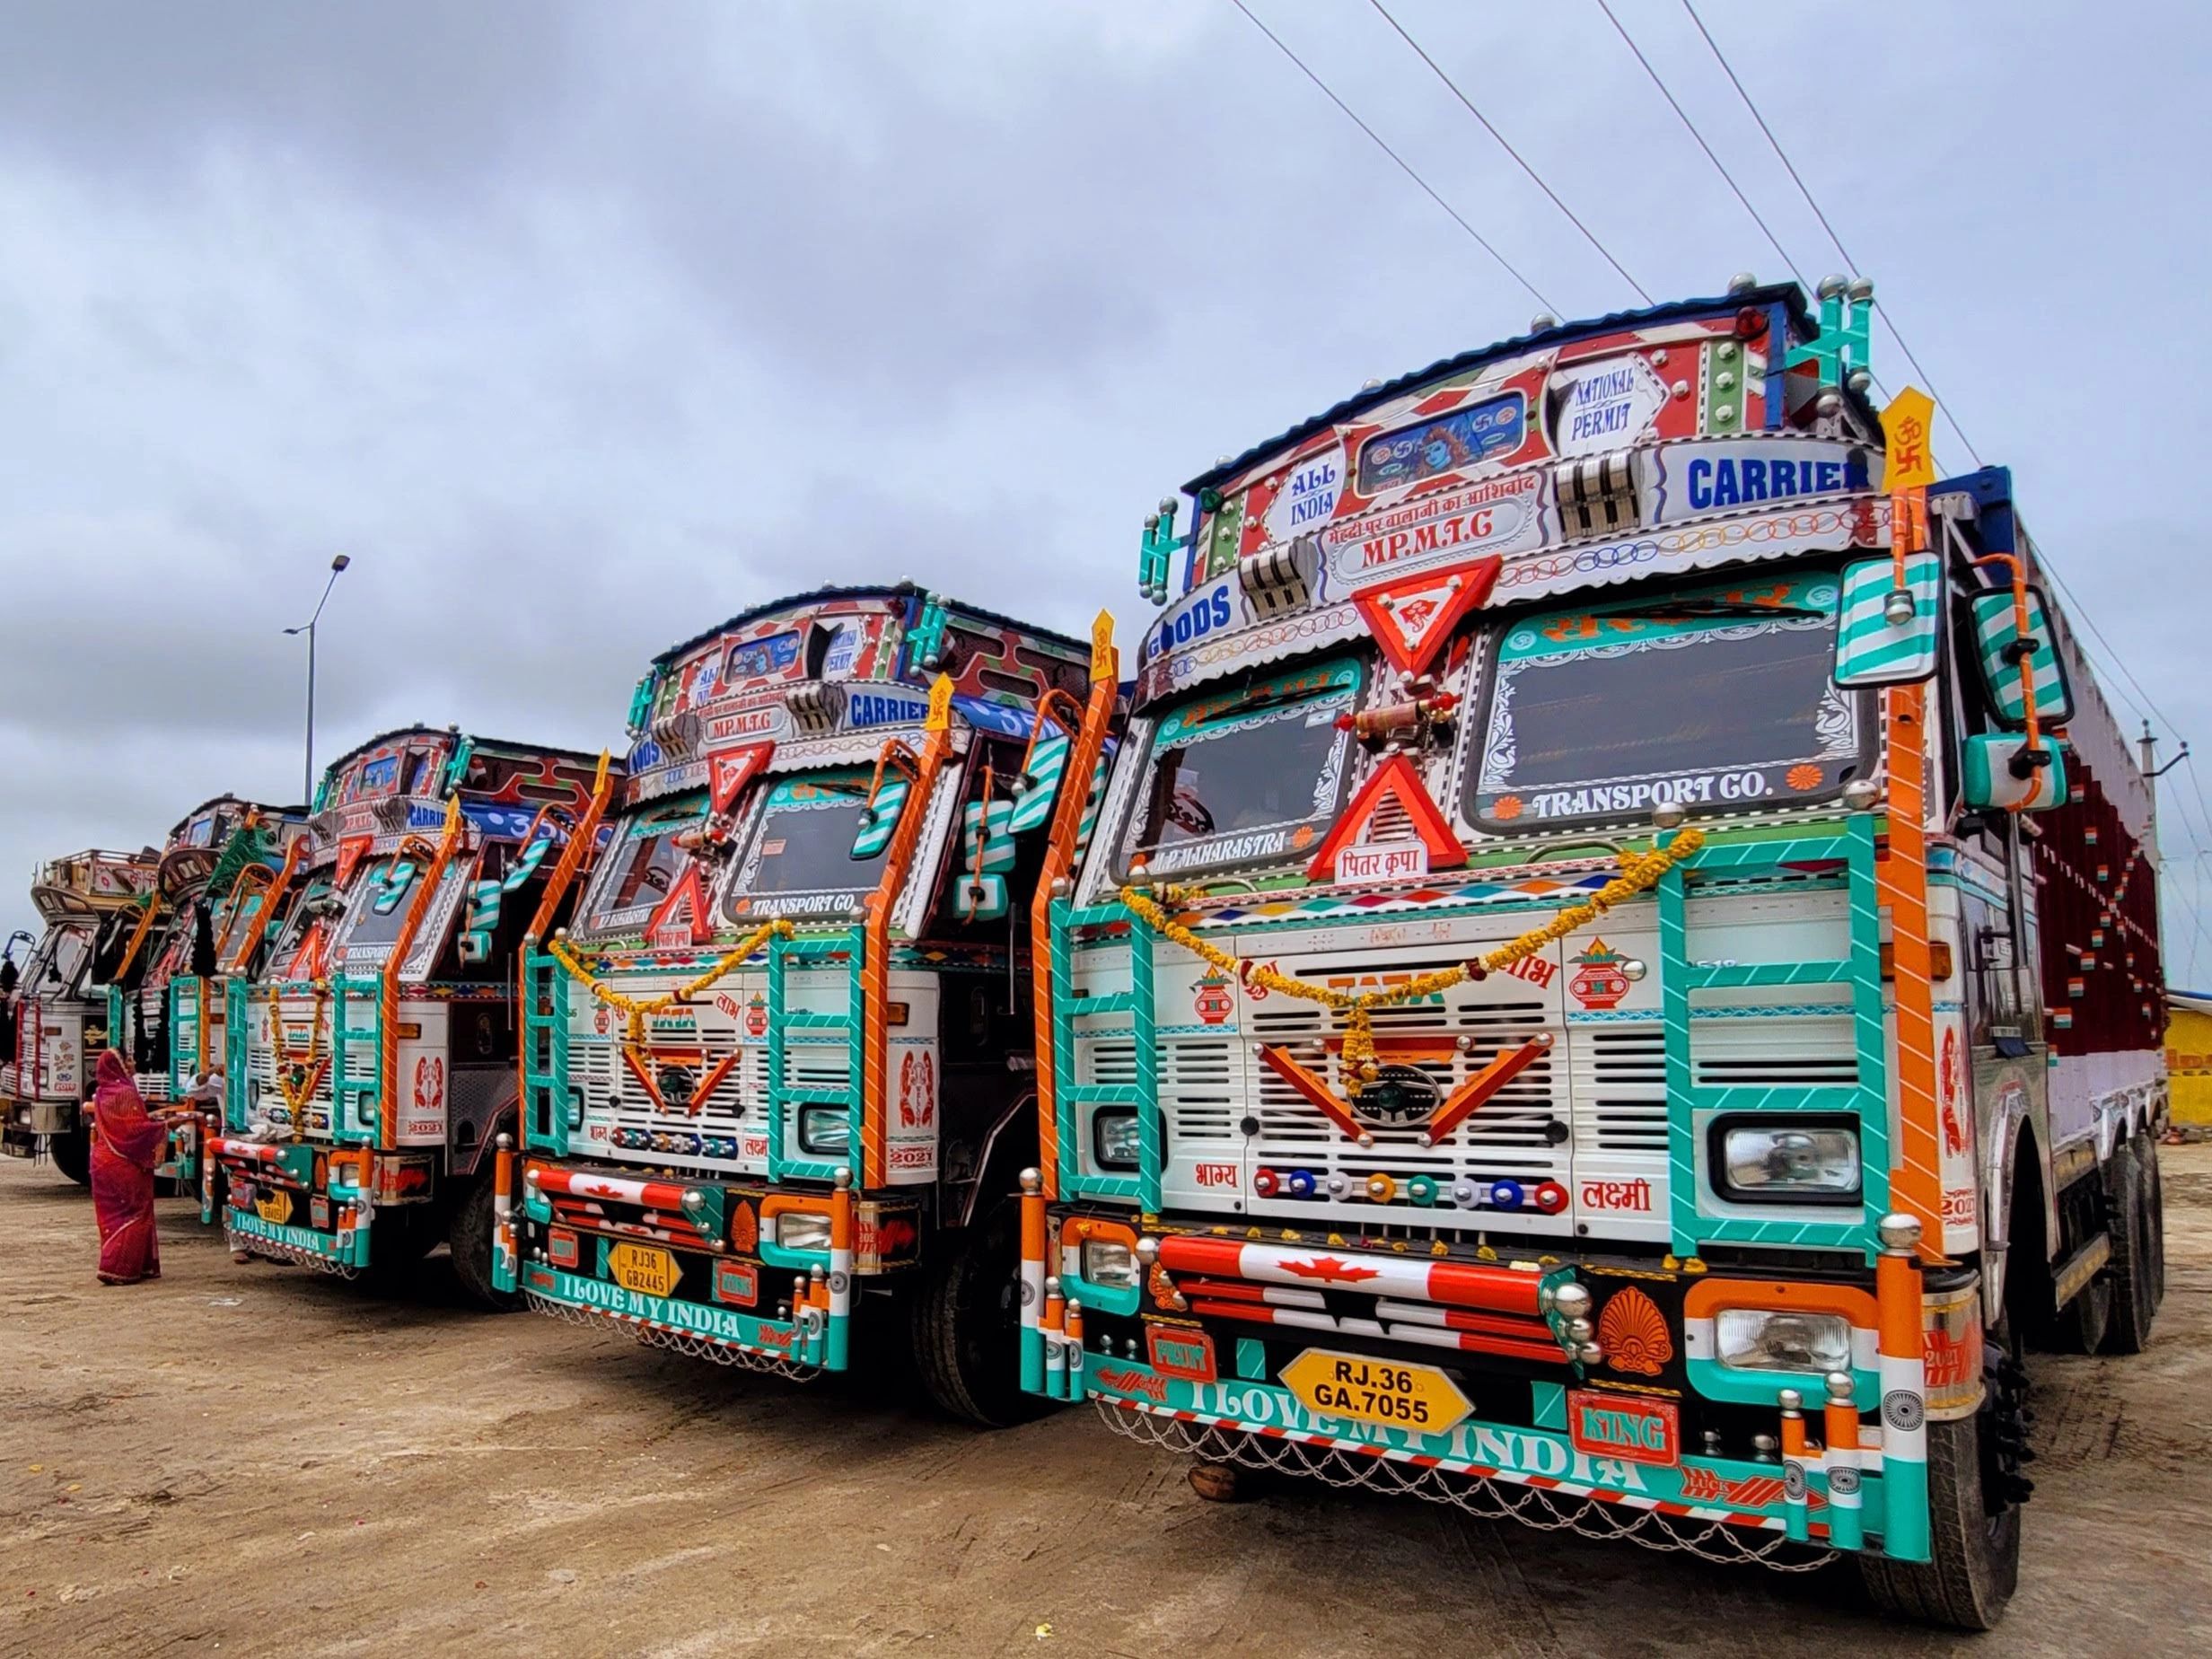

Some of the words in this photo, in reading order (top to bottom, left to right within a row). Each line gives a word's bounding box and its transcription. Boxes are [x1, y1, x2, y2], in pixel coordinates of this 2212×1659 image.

[1575, 366, 1636, 406] NATIONAL
[1571, 402, 1632, 441] PERMIT
[1292, 463, 1336, 496] ALL
[1291, 491, 1334, 526] INDIA
[1443, 497, 1463, 514] का
[1532, 775, 1715, 820] TRANSPORT
[1719, 770, 1775, 798] CO.
[1340, 849, 1381, 879] पितर
[1383, 847, 1421, 880] कृपा
[751, 896, 835, 917] TRANSPORT
[890, 1153, 933, 1164] 2021
[1196, 1163, 1238, 1188] भाग्य
[1581, 1177, 1652, 1212] लक्ष्मी
[286, 1225, 320, 1251] INDIA
[631, 1249, 657, 1269] RJ36
[626, 1270, 665, 1293] GB2445
[572, 1277, 625, 1310] LOVE
[628, 1291, 664, 1322] MY
[665, 1302, 741, 1339] INDIA
[1333, 1360, 1413, 1394] RJ.36
[1314, 1383, 1429, 1423] GA.7055
[1581, 1407, 1665, 1452] KING
[1688, 1477, 1730, 1493] LUCK
